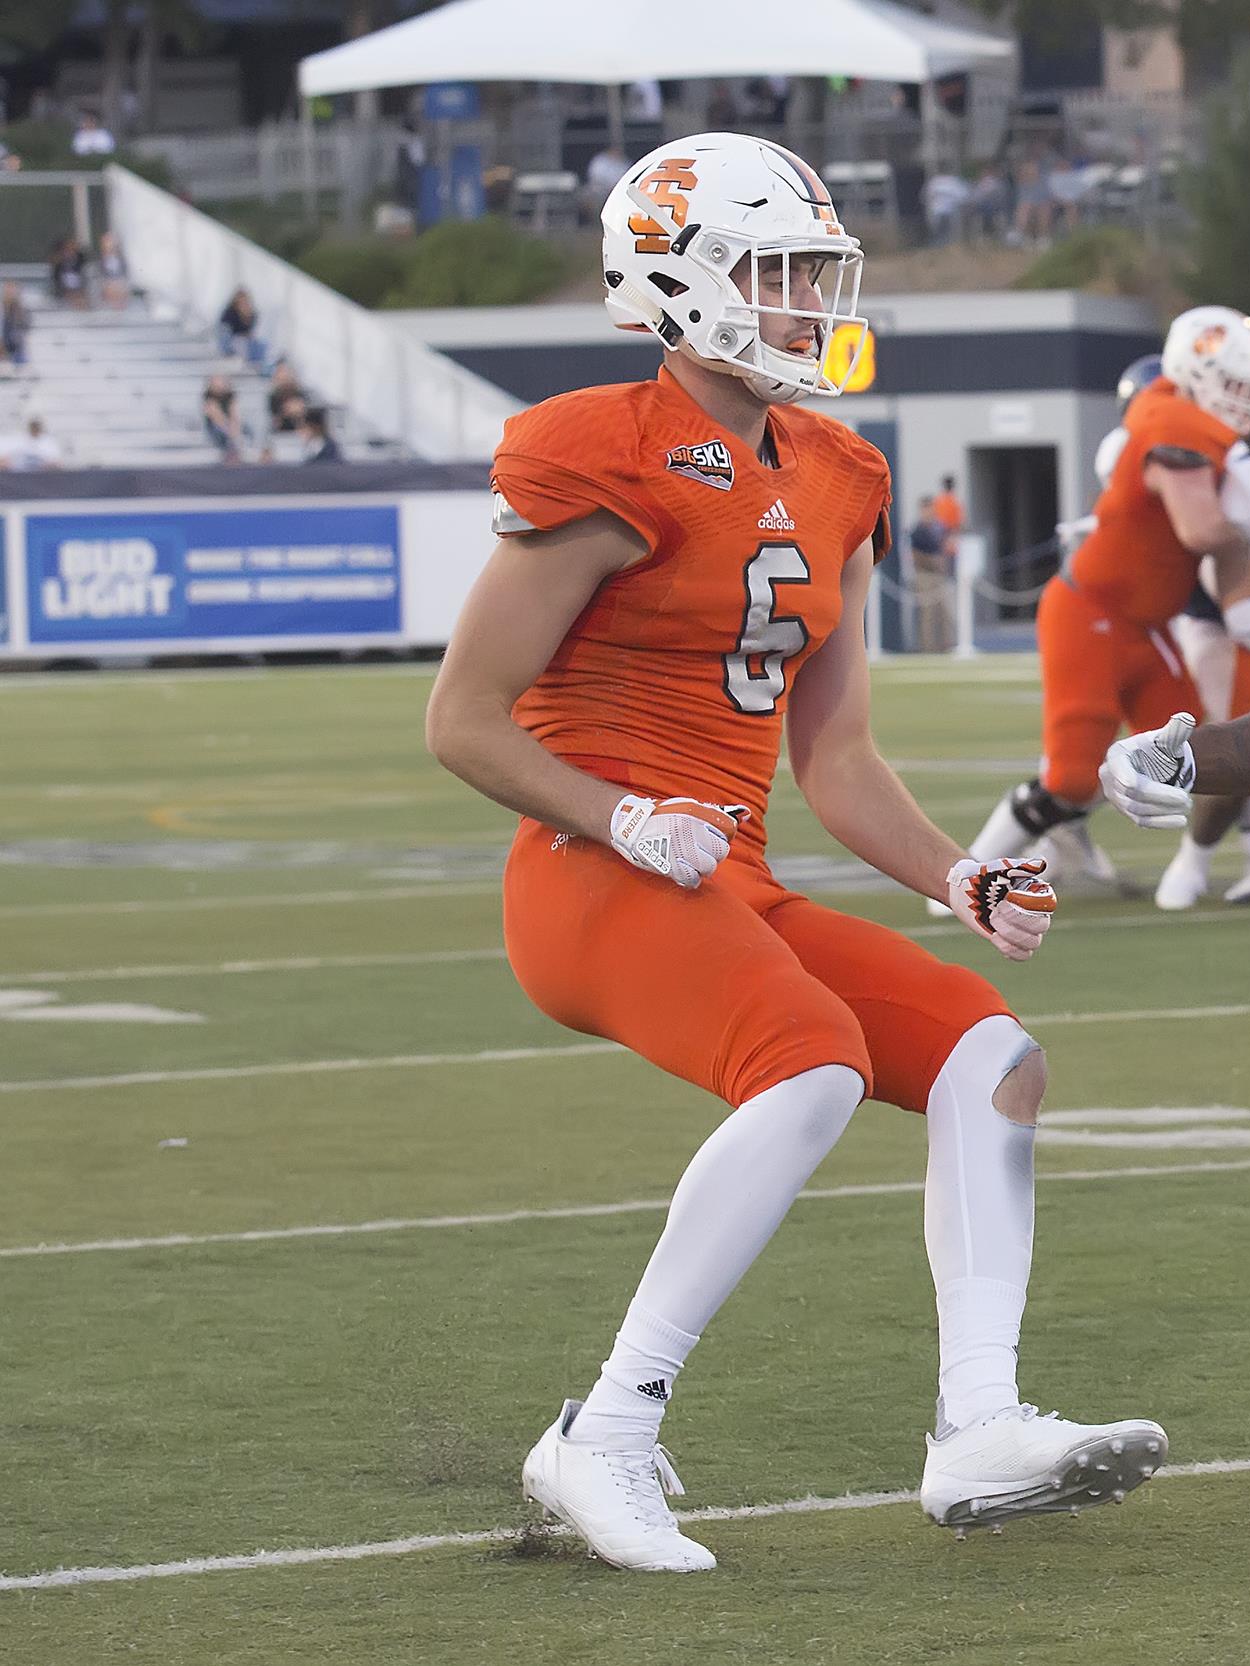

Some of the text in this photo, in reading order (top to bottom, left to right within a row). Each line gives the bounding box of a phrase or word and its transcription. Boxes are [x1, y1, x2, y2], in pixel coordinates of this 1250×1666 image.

[692, 443, 730, 469] SKY
[757, 516, 796, 530] adidas
[60, 538, 157, 577] BUD
[42, 574, 175, 619] LIGHT
[721, 540, 812, 716] 6
[638, 842, 669, 872] adidas
